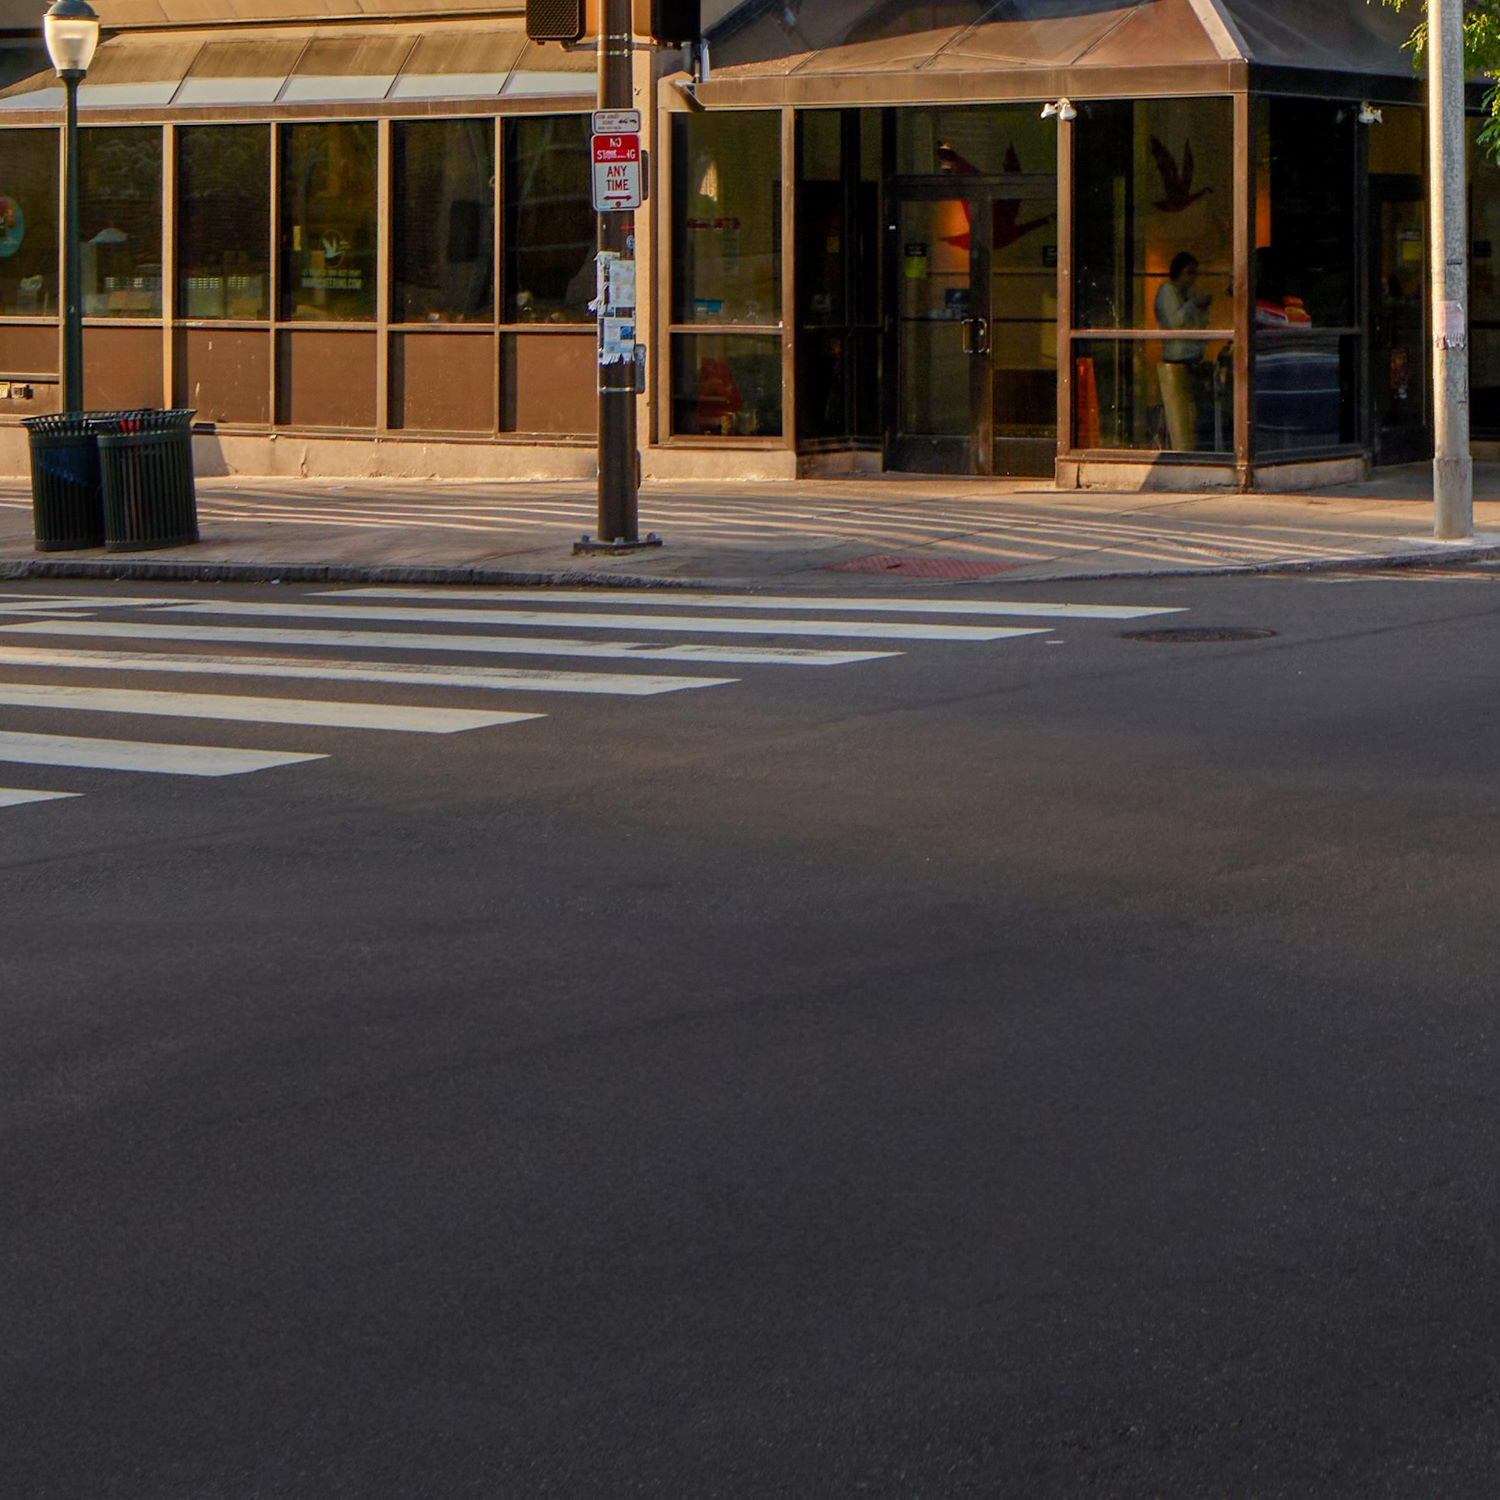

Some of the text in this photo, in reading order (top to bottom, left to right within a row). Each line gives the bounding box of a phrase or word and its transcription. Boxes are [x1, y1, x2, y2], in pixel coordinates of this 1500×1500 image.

[609, 137, 622, 148] NO
[606, 166, 627, 177] ANY
[606, 179, 629, 191] TIME
